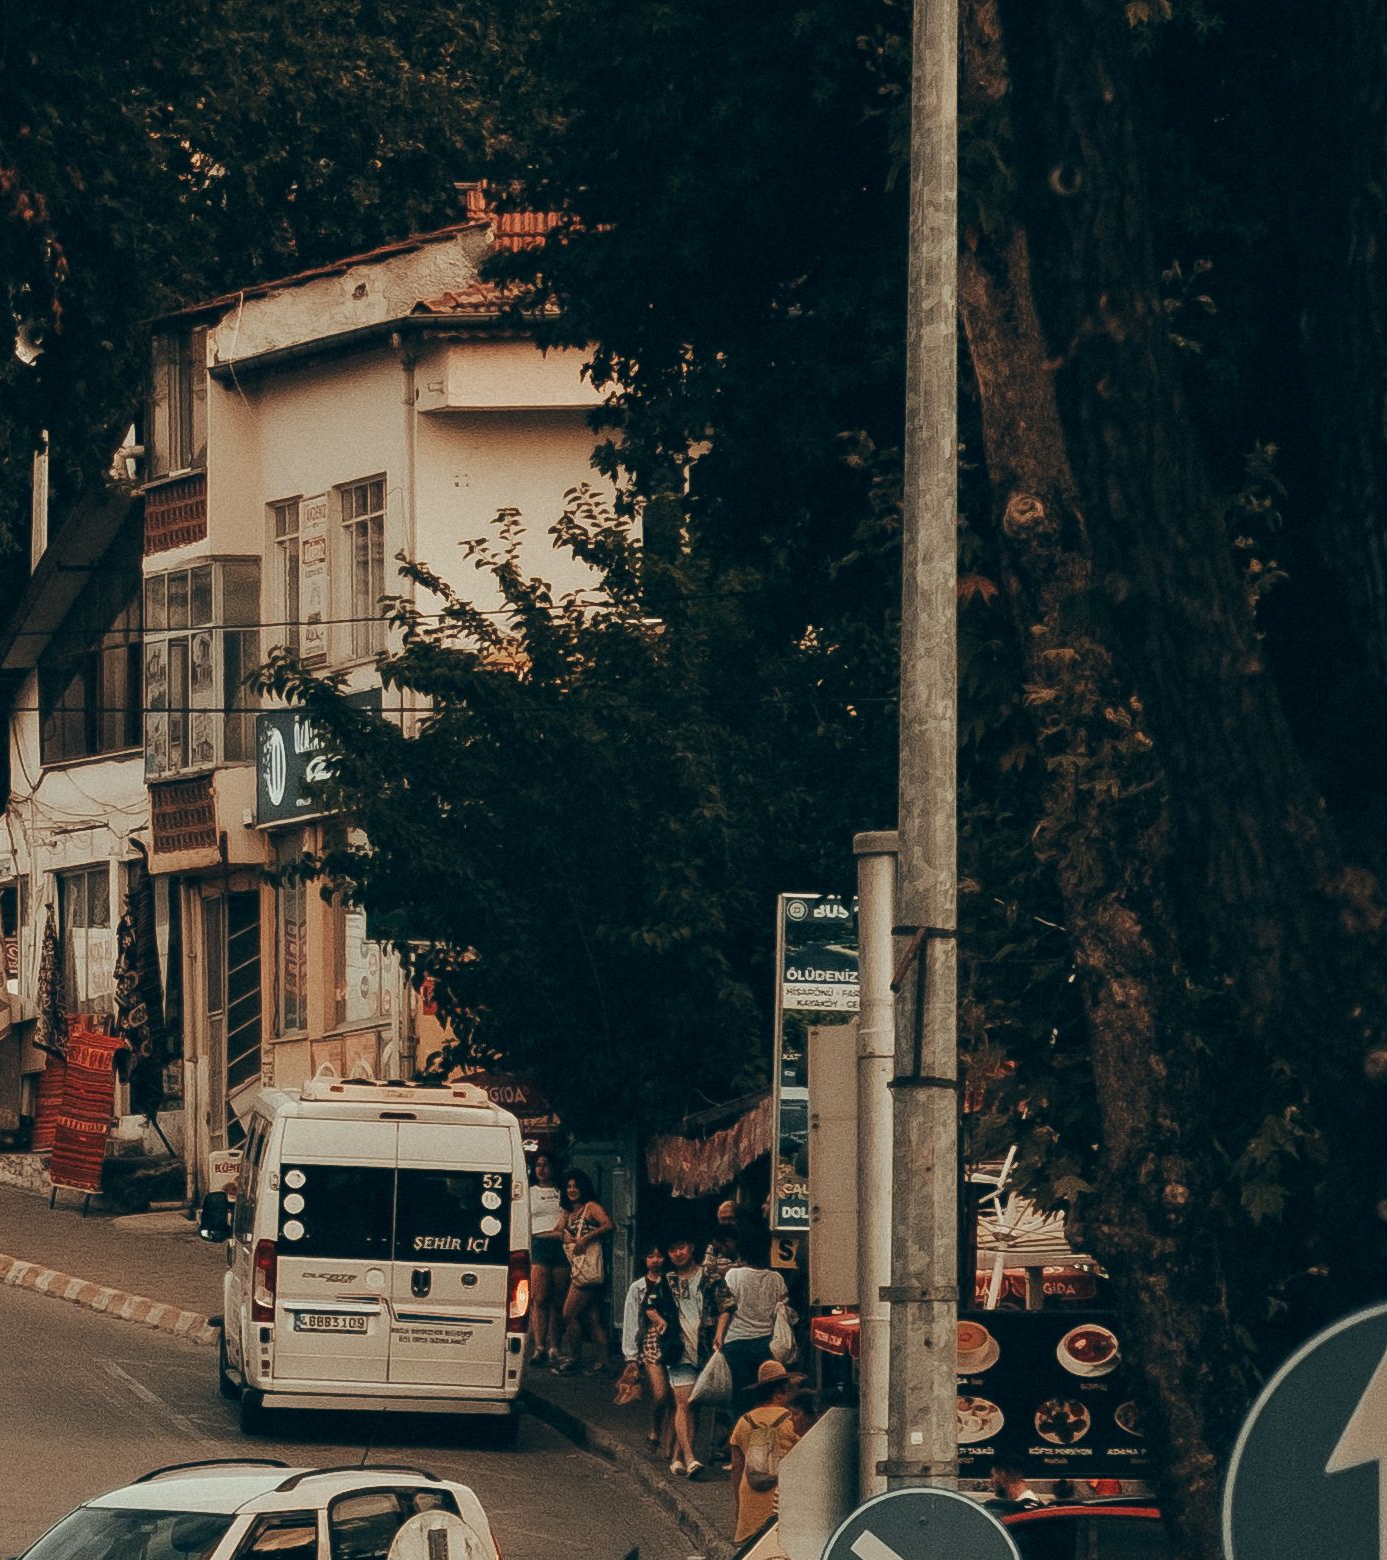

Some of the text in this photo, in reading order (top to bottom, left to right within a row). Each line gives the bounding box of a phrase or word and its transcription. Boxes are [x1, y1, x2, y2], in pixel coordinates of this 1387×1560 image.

[482, 1174, 503, 1189] 52
[781, 1206, 809, 1219] DOL
[413, 1236, 489, 1253] ŞEHİR İÇİ
[779, 1240, 794, 1262] S
